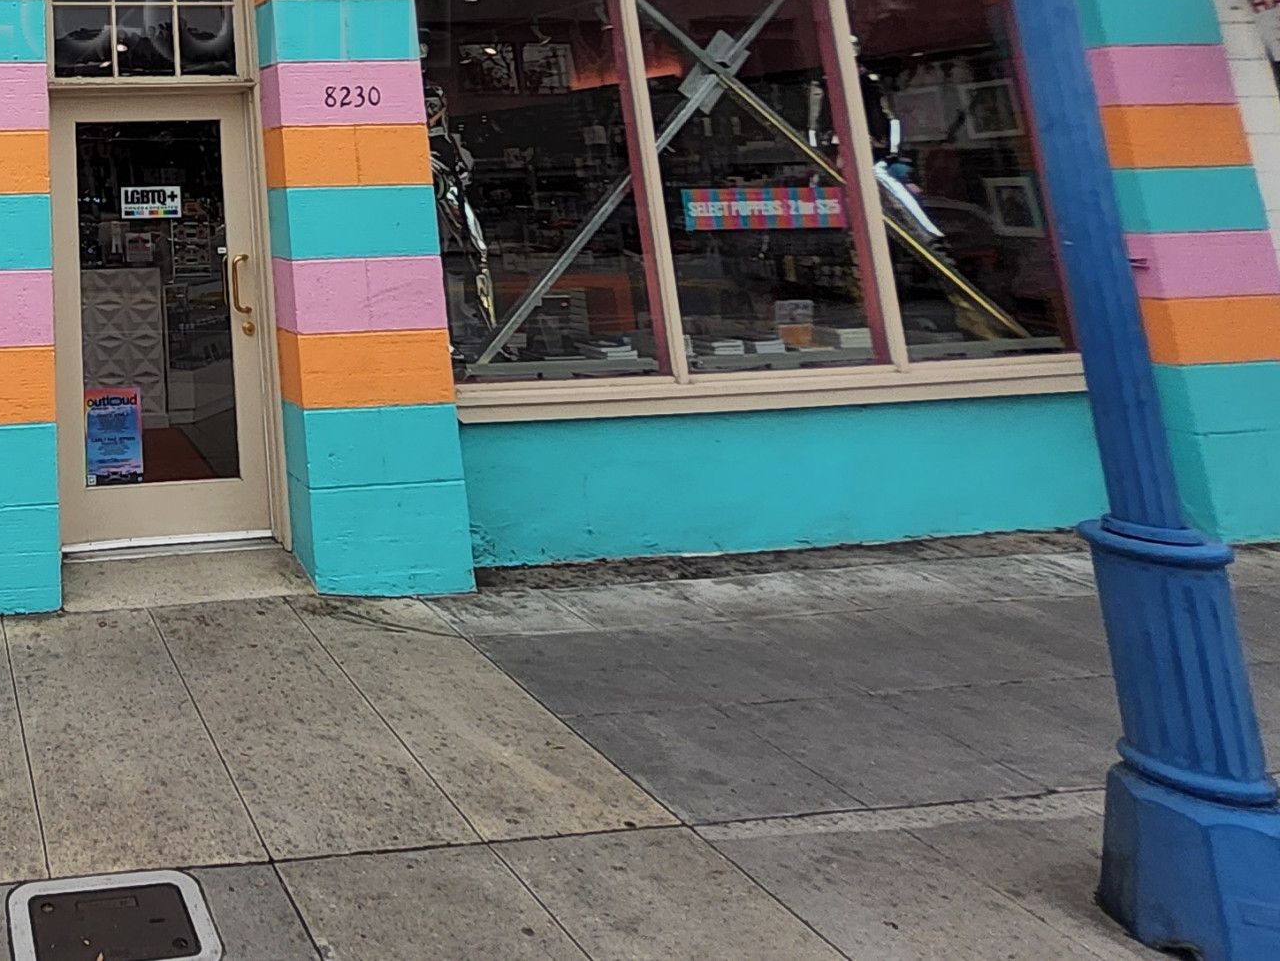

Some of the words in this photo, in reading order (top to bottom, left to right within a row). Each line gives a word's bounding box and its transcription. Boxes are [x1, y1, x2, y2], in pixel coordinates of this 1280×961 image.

[324, 85, 381, 109] 8230
[124, 189, 178, 206] LGBTQ+
[86, 394, 138, 407] outloud
